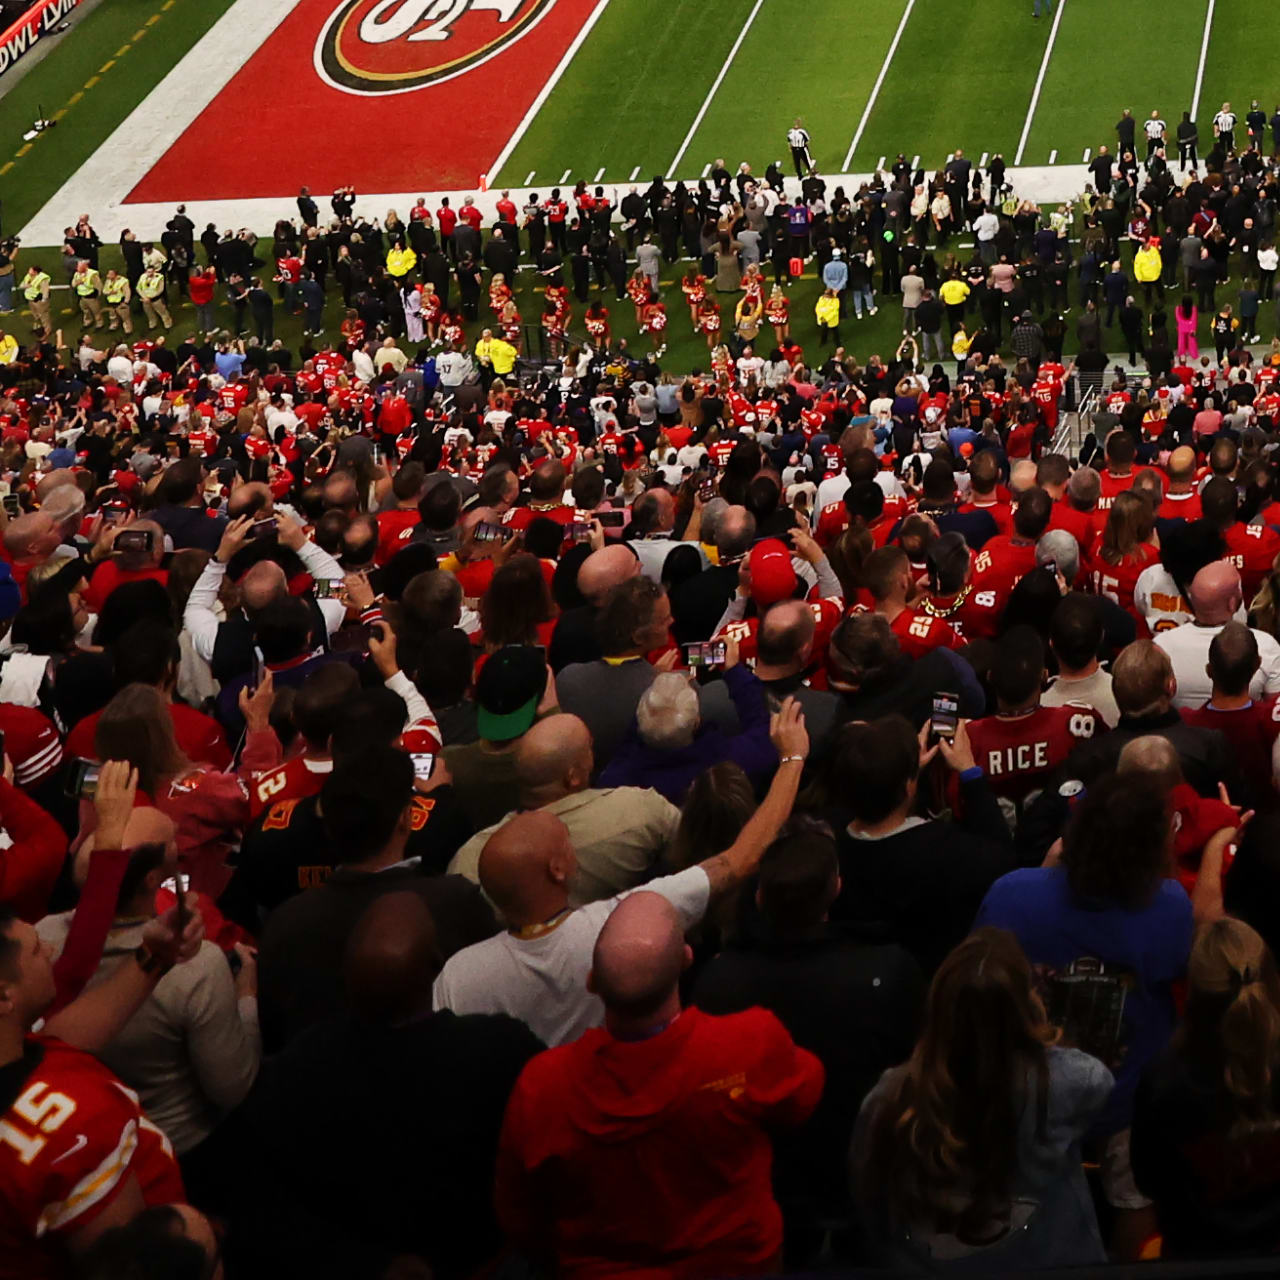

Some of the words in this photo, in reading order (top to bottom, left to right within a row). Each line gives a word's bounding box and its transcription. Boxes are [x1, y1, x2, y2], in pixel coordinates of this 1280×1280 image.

[441, 363, 452, 374] 17
[223, 395, 235, 408] 15
[1109, 401, 1125, 414] 87
[826, 457, 839, 469] 15
[974, 550, 992, 573] 95
[989, 742, 1048, 776] RICE
[0, 1080, 77, 1165] 15
